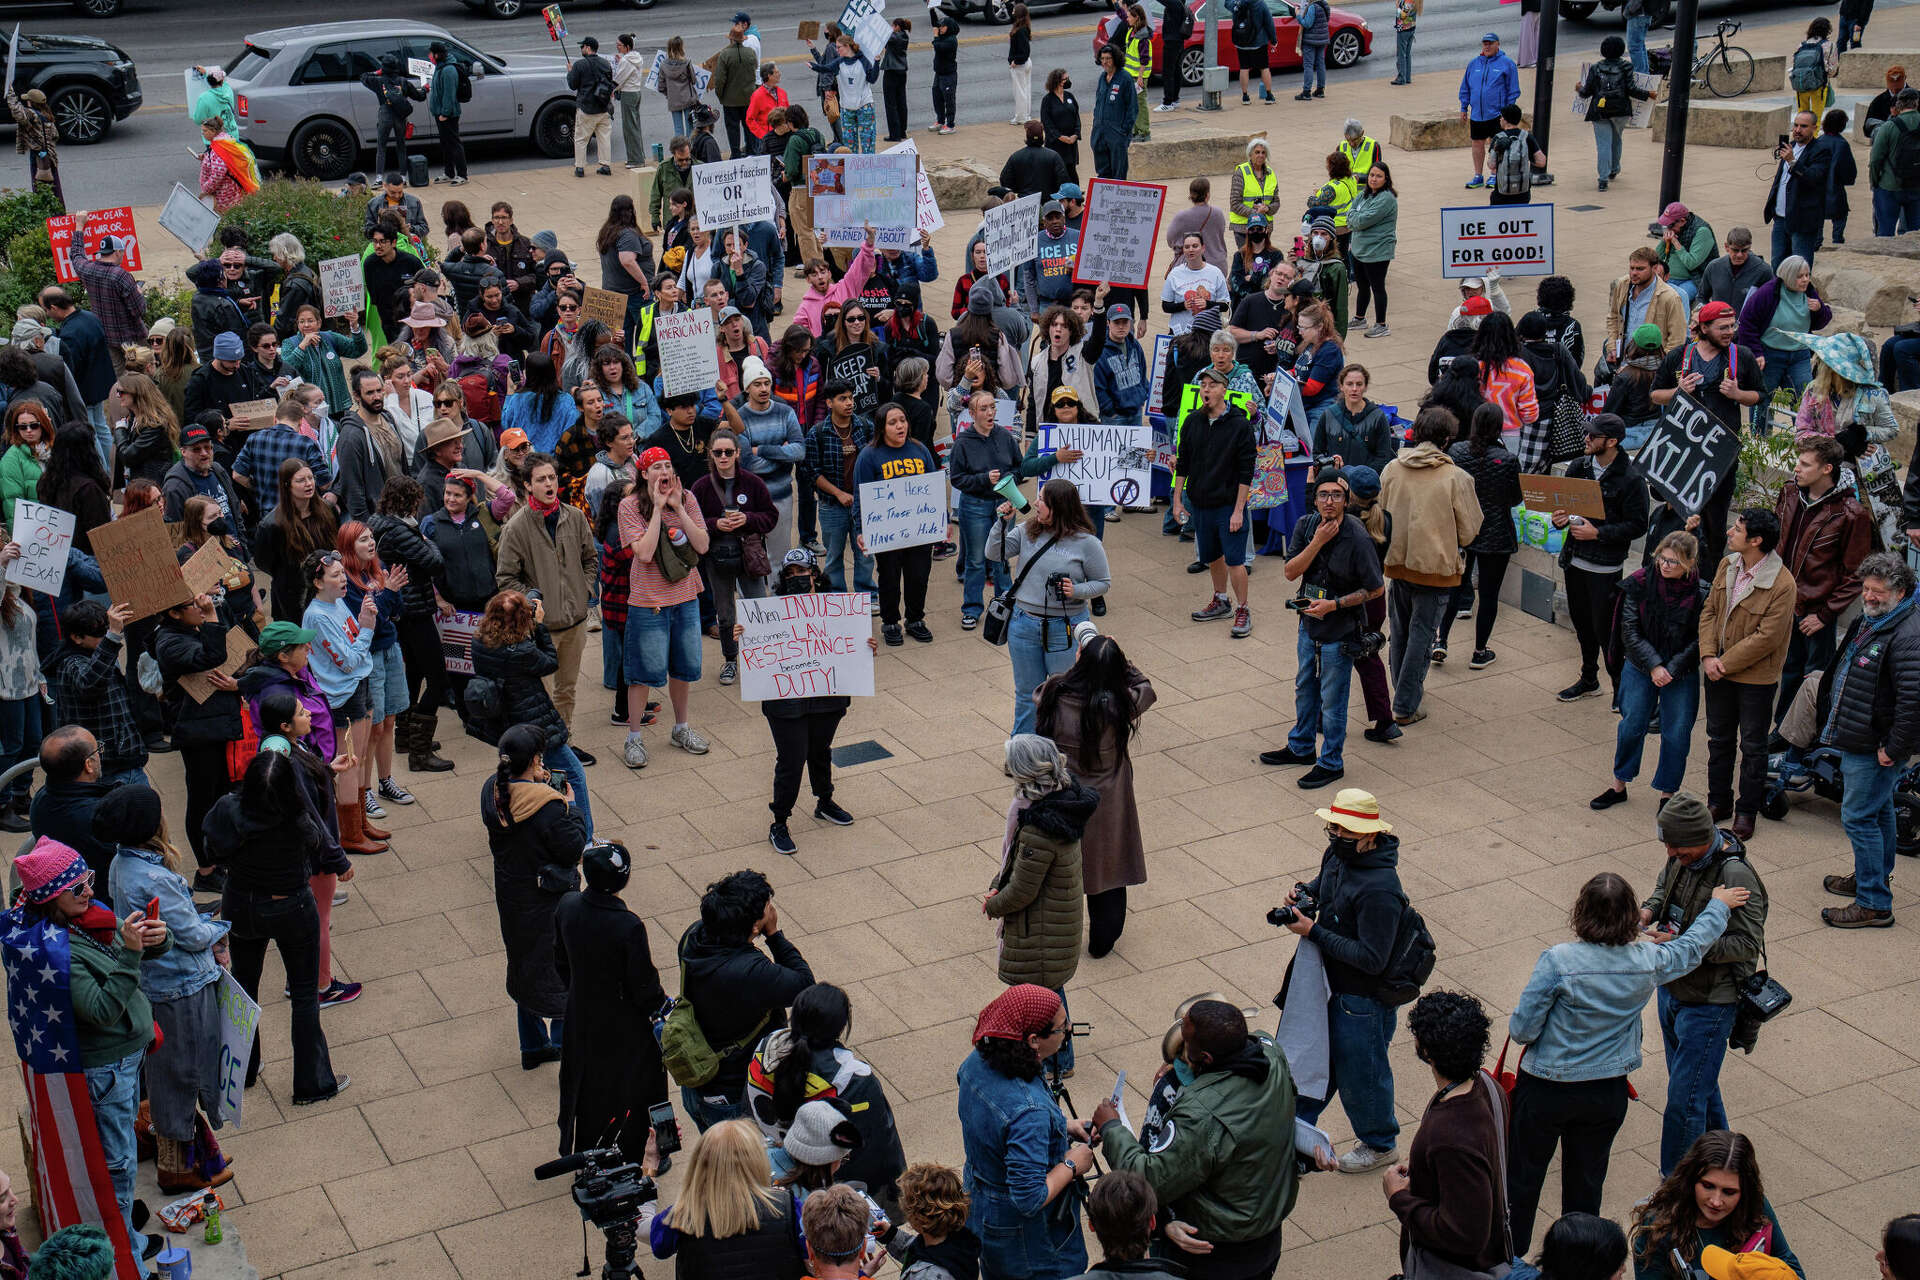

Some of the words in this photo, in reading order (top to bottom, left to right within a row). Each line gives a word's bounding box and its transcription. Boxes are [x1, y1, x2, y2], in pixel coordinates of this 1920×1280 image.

[696, 170, 712, 185] You
[715, 165, 737, 182] resist
[740, 164, 768, 179] fascism
[723, 185, 742, 201] OR
[49, 216, 70, 227] NICE
[702, 210, 717, 225] You
[717, 204, 740, 221] assist
[742, 203, 770, 218] fascism
[52, 230, 69, 240] ARE
[94, 224, 111, 235] WAR
[830, 229, 862, 241] WARNED
[878, 231, 906, 244] ABOUT
[1460, 222, 1486, 236] ICE
[1498, 220, 1534, 234] OUT
[1041, 245, 1061, 259] ICE
[1066, 244, 1077, 257] IS
[1452, 249, 1484, 263] FOR
[1492, 246, 1543, 261] GOOD!
[334, 269, 350, 280] APD
[330, 296, 348, 305] NAZI
[665, 315, 680, 326] THIS
[683, 312, 695, 323] AN
[834, 355, 867, 379] KEEP
[1665, 394, 1726, 457] ICE
[1038, 424, 1140, 454] INHUMANE
[881, 458, 925, 480] UCSB
[1639, 427, 1717, 512] KILLS
[22, 503, 60, 528] ICE
[34, 526, 71, 549] OUT
[28, 542, 50, 558] OF
[15, 555, 60, 584] TEXAS
[742, 599, 780, 625] When
[780, 592, 871, 621] INJUSTICE
[742, 630, 791, 647] becomes
[791, 620, 829, 641] LAW
[741, 636, 857, 671] RESISTANCE
[779, 659, 821, 673] becomes
[772, 665, 837, 698] DUTY!
